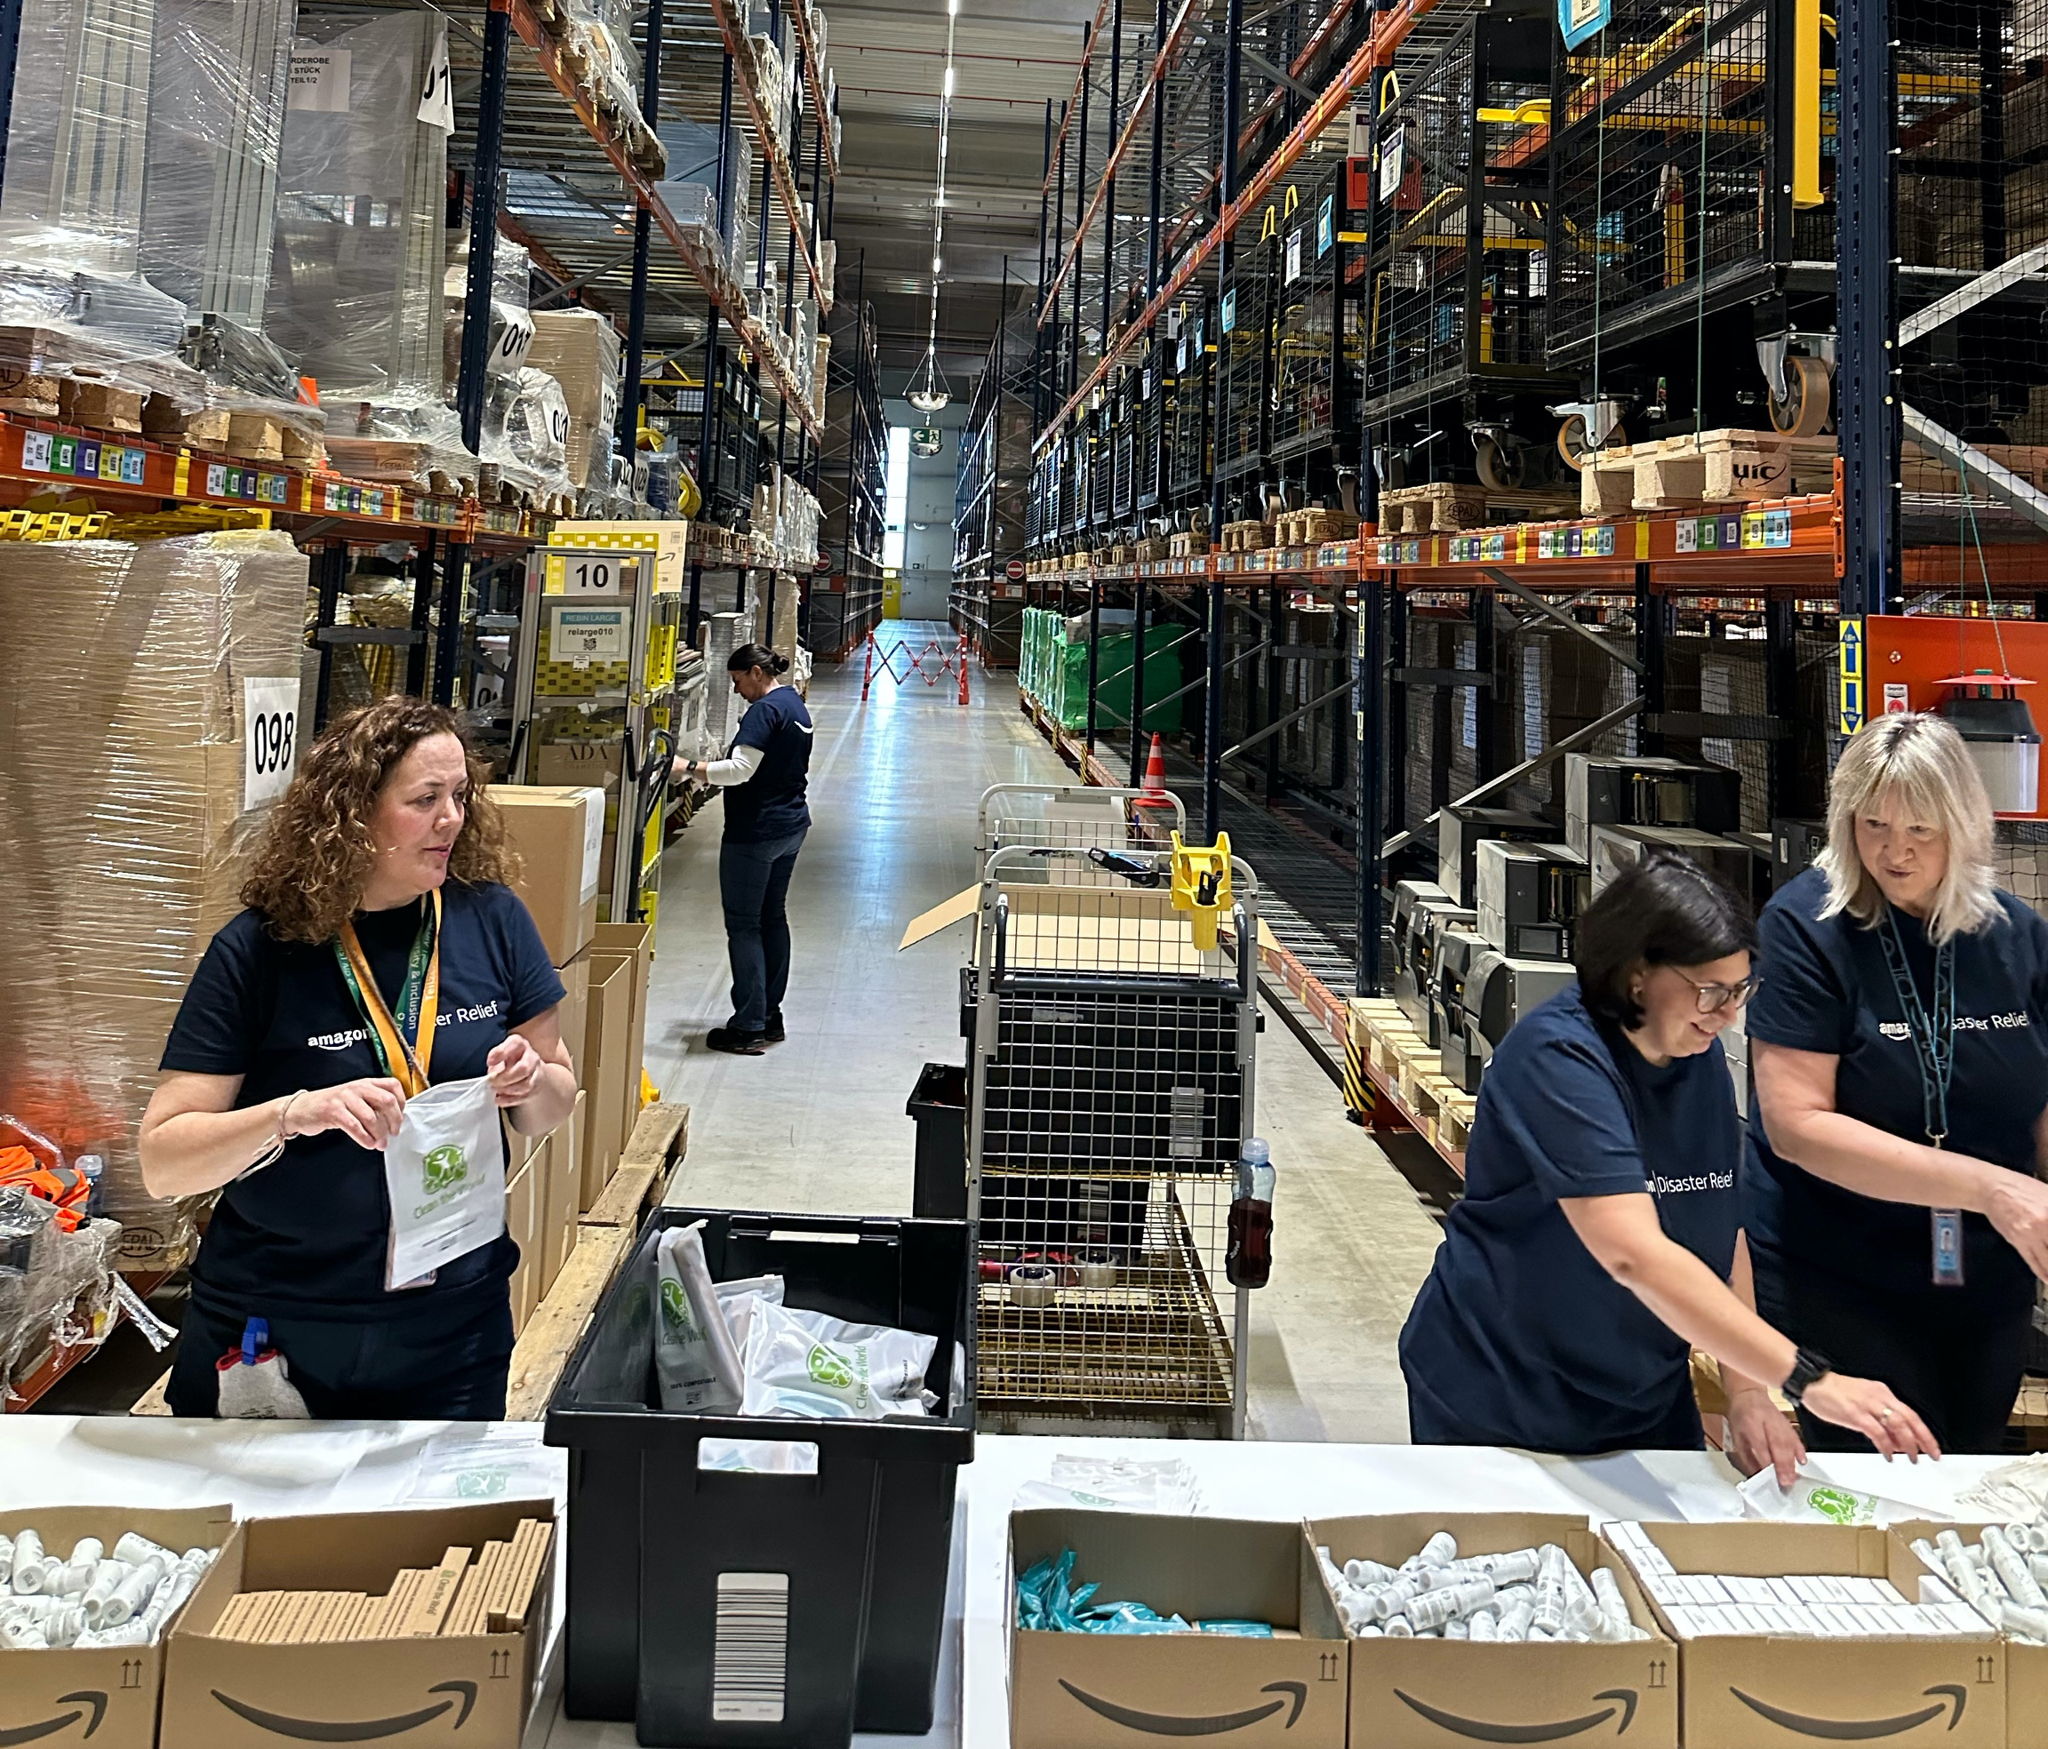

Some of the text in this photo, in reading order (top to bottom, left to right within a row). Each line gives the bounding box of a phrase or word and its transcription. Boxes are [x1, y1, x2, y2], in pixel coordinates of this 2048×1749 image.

[294, 66, 321, 74] STÜCK
[1452, 503, 1476, 517] EPAL
[576, 563, 609, 588] 10
[565, 614, 617, 622] REBIN LARGE
[254, 711, 294, 775] 098
[569, 744, 608, 761] ADA
[456, 1000, 499, 1023] Relief
[1656, 1174, 1708, 1193] Disaster
[121, 1234, 157, 1251] EPAL
